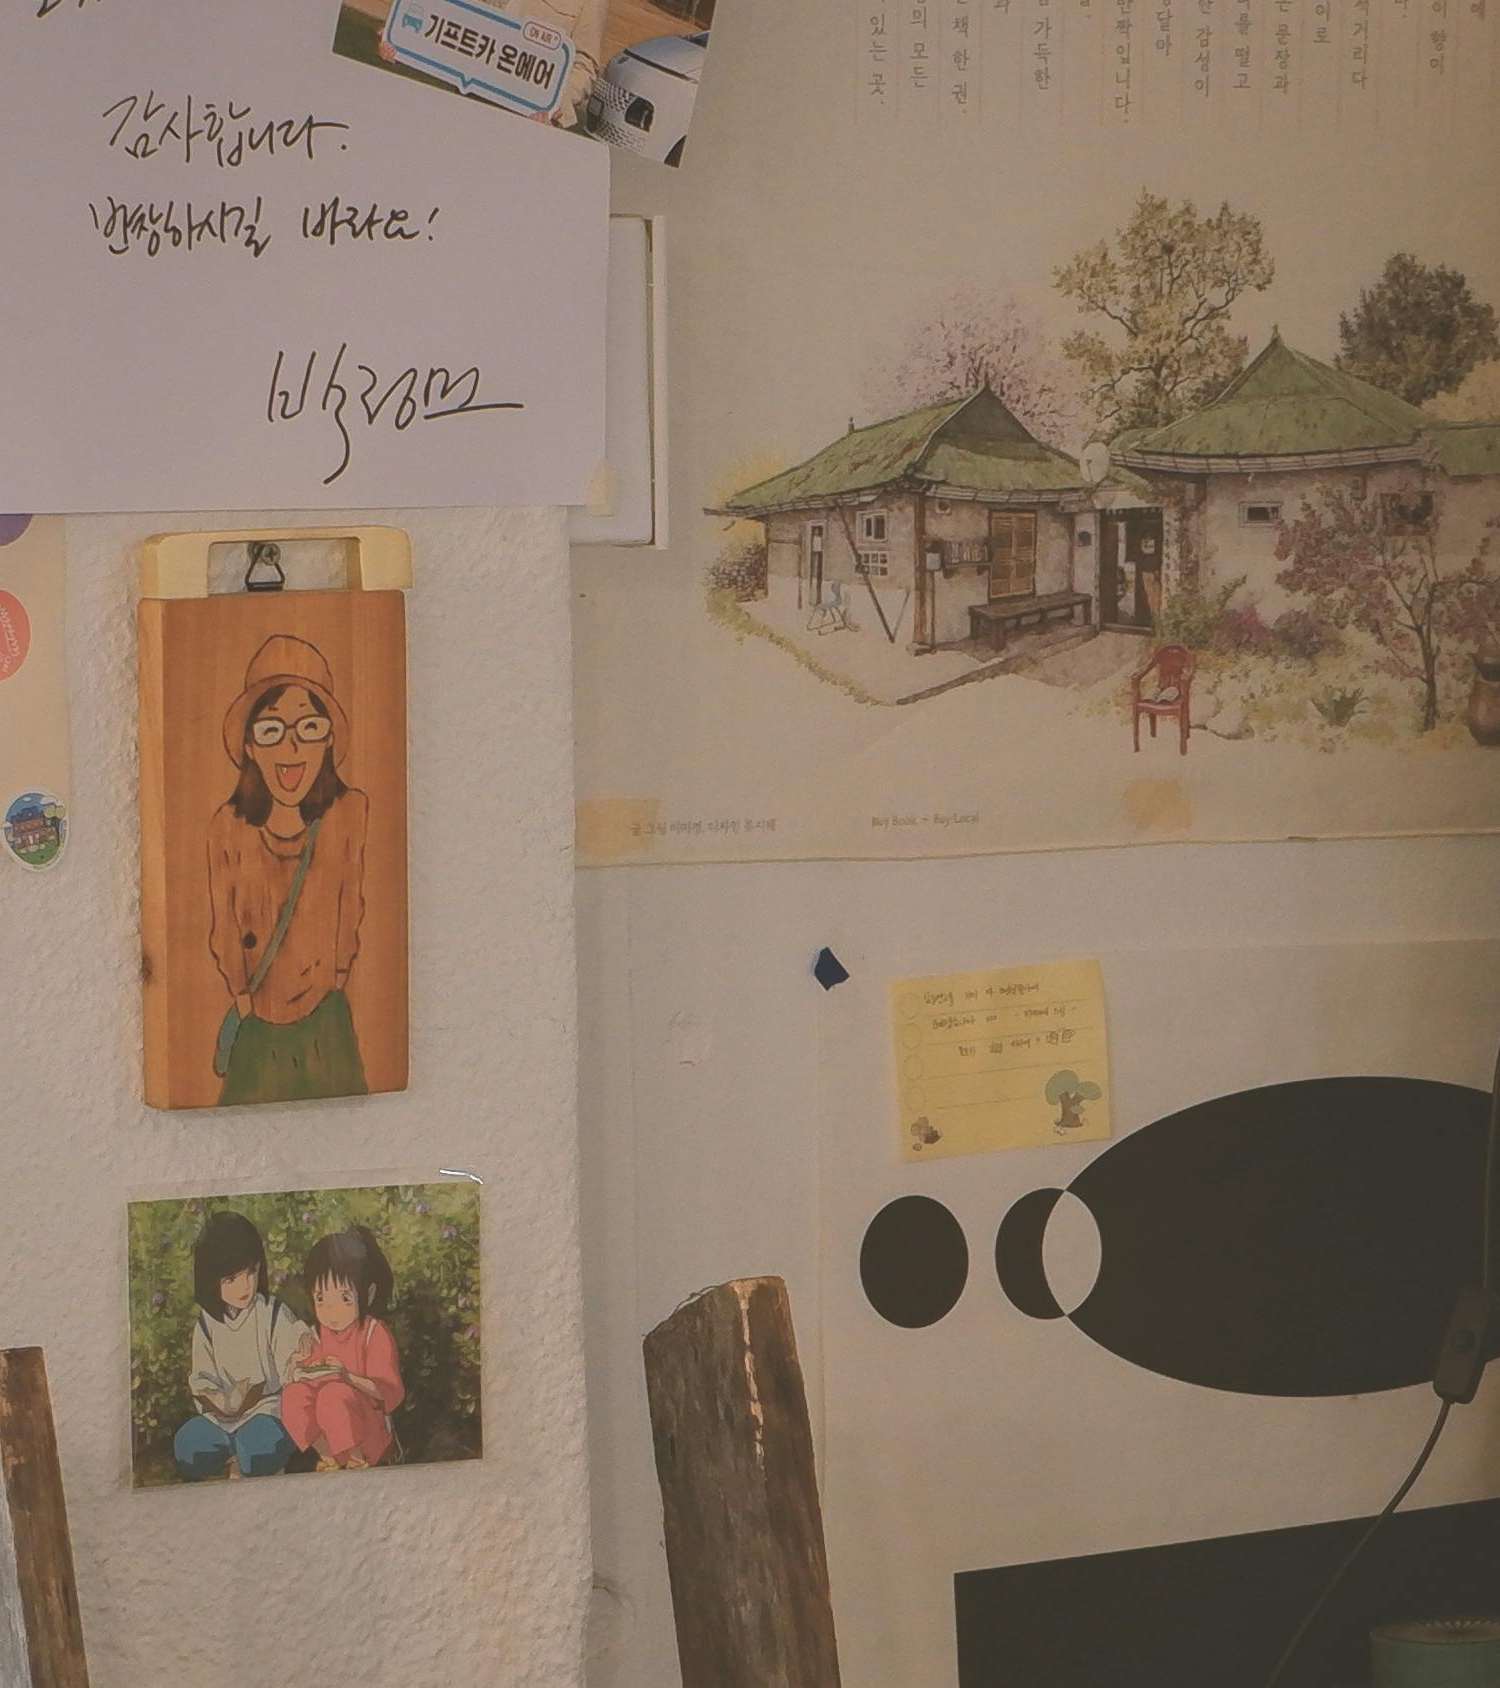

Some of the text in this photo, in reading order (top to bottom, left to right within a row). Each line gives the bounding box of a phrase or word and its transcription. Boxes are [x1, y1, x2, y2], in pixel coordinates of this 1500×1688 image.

[952, 16, 969, 38] 책
[425, 14, 555, 90] 기프트카 온에어
[953, 50, 969, 72] 한
[102, 91, 350, 167] 감사합니다.
